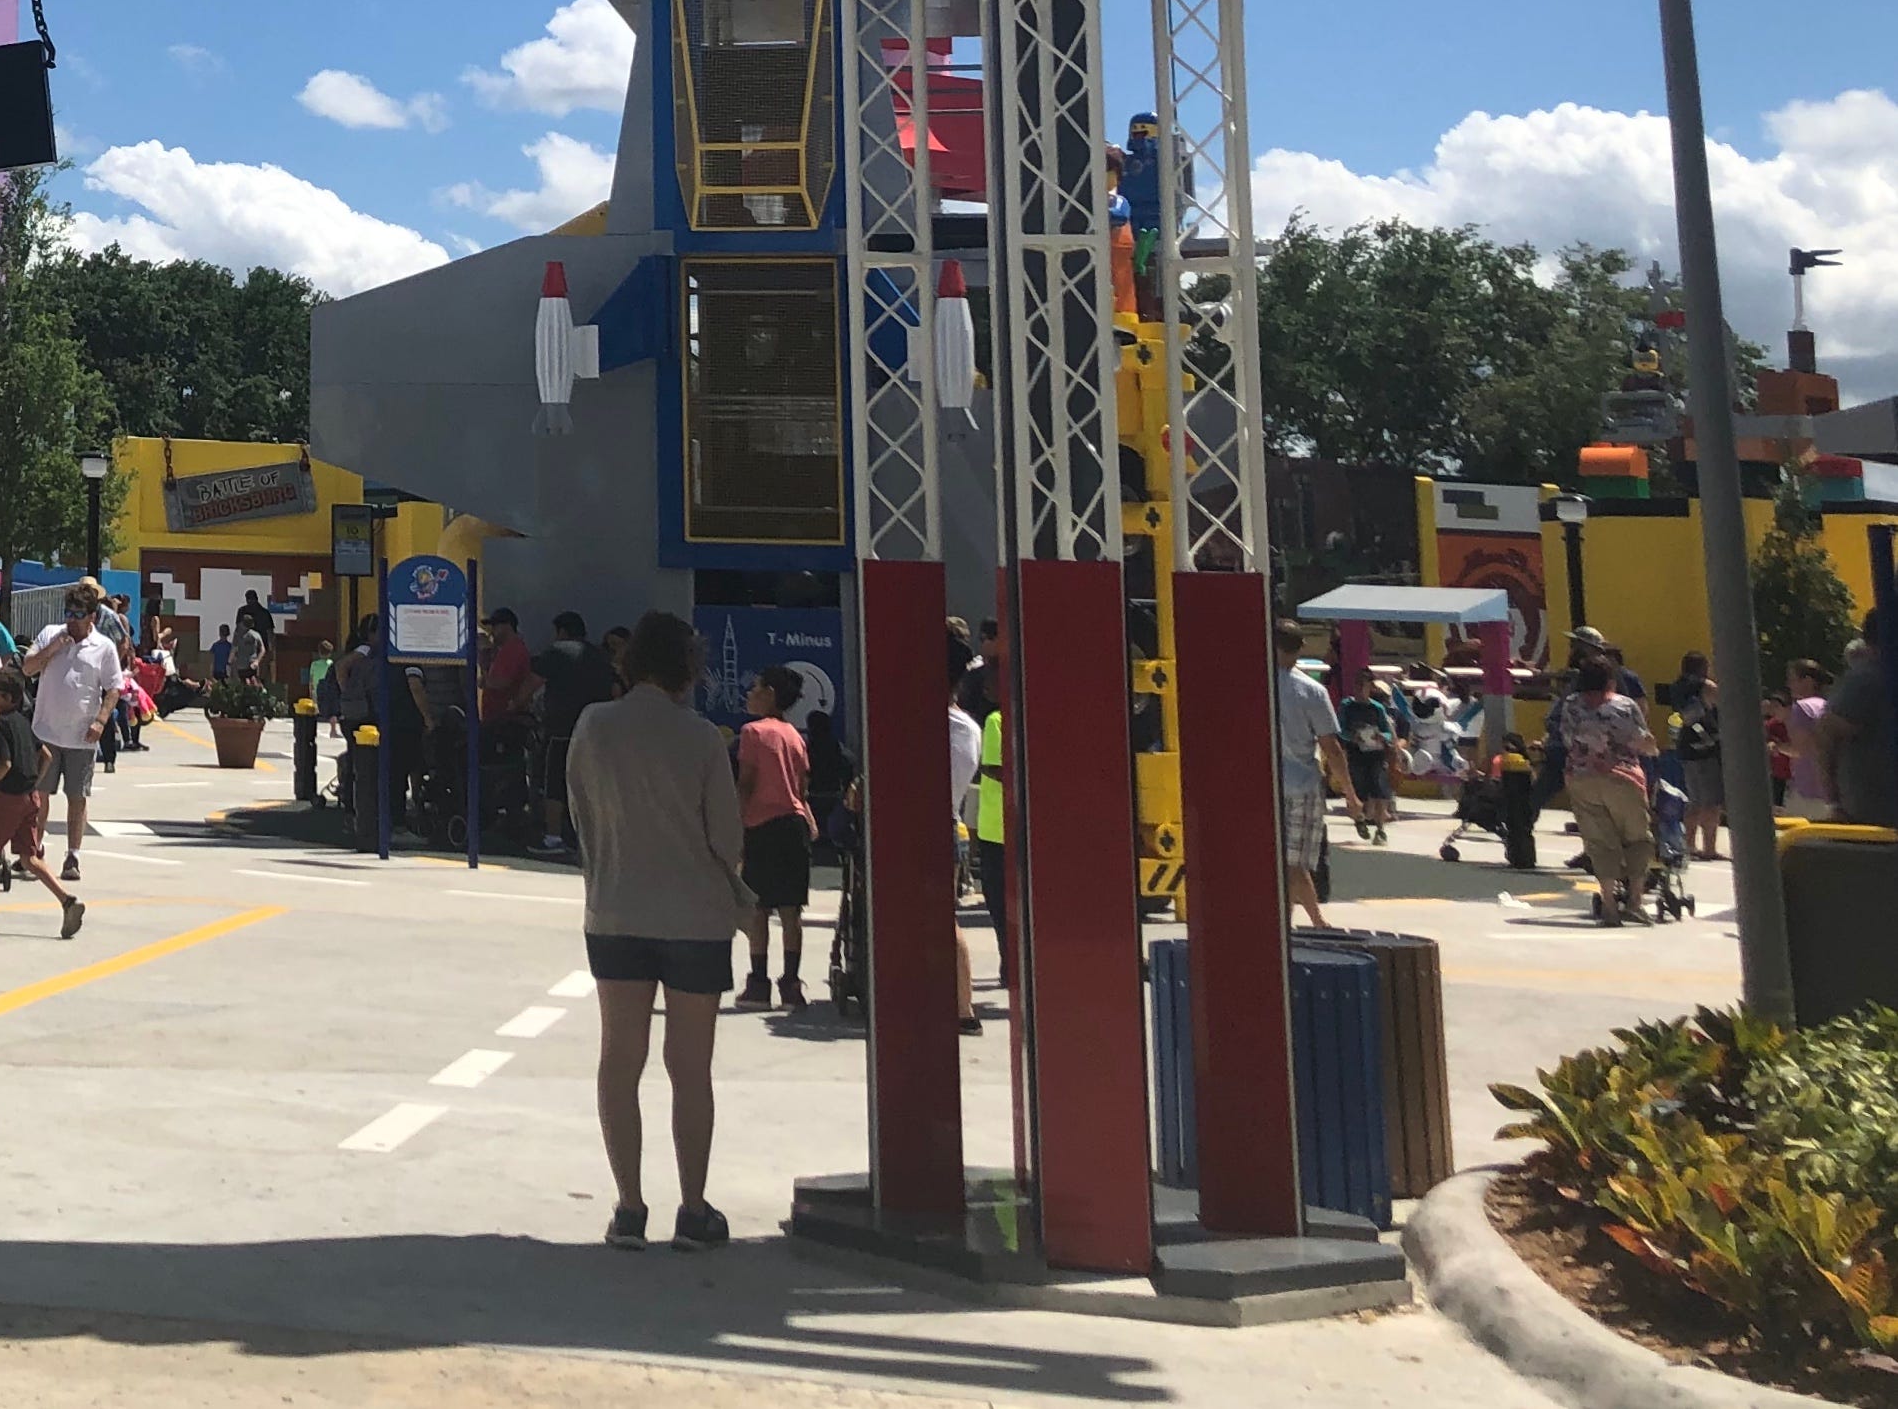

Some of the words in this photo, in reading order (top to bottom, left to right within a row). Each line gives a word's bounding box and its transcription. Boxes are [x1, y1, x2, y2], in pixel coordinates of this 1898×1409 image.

[192, 483, 297, 523] BRICKSBURG
[197, 474, 253, 504] BATTLE
[260, 470, 280, 487] OF
